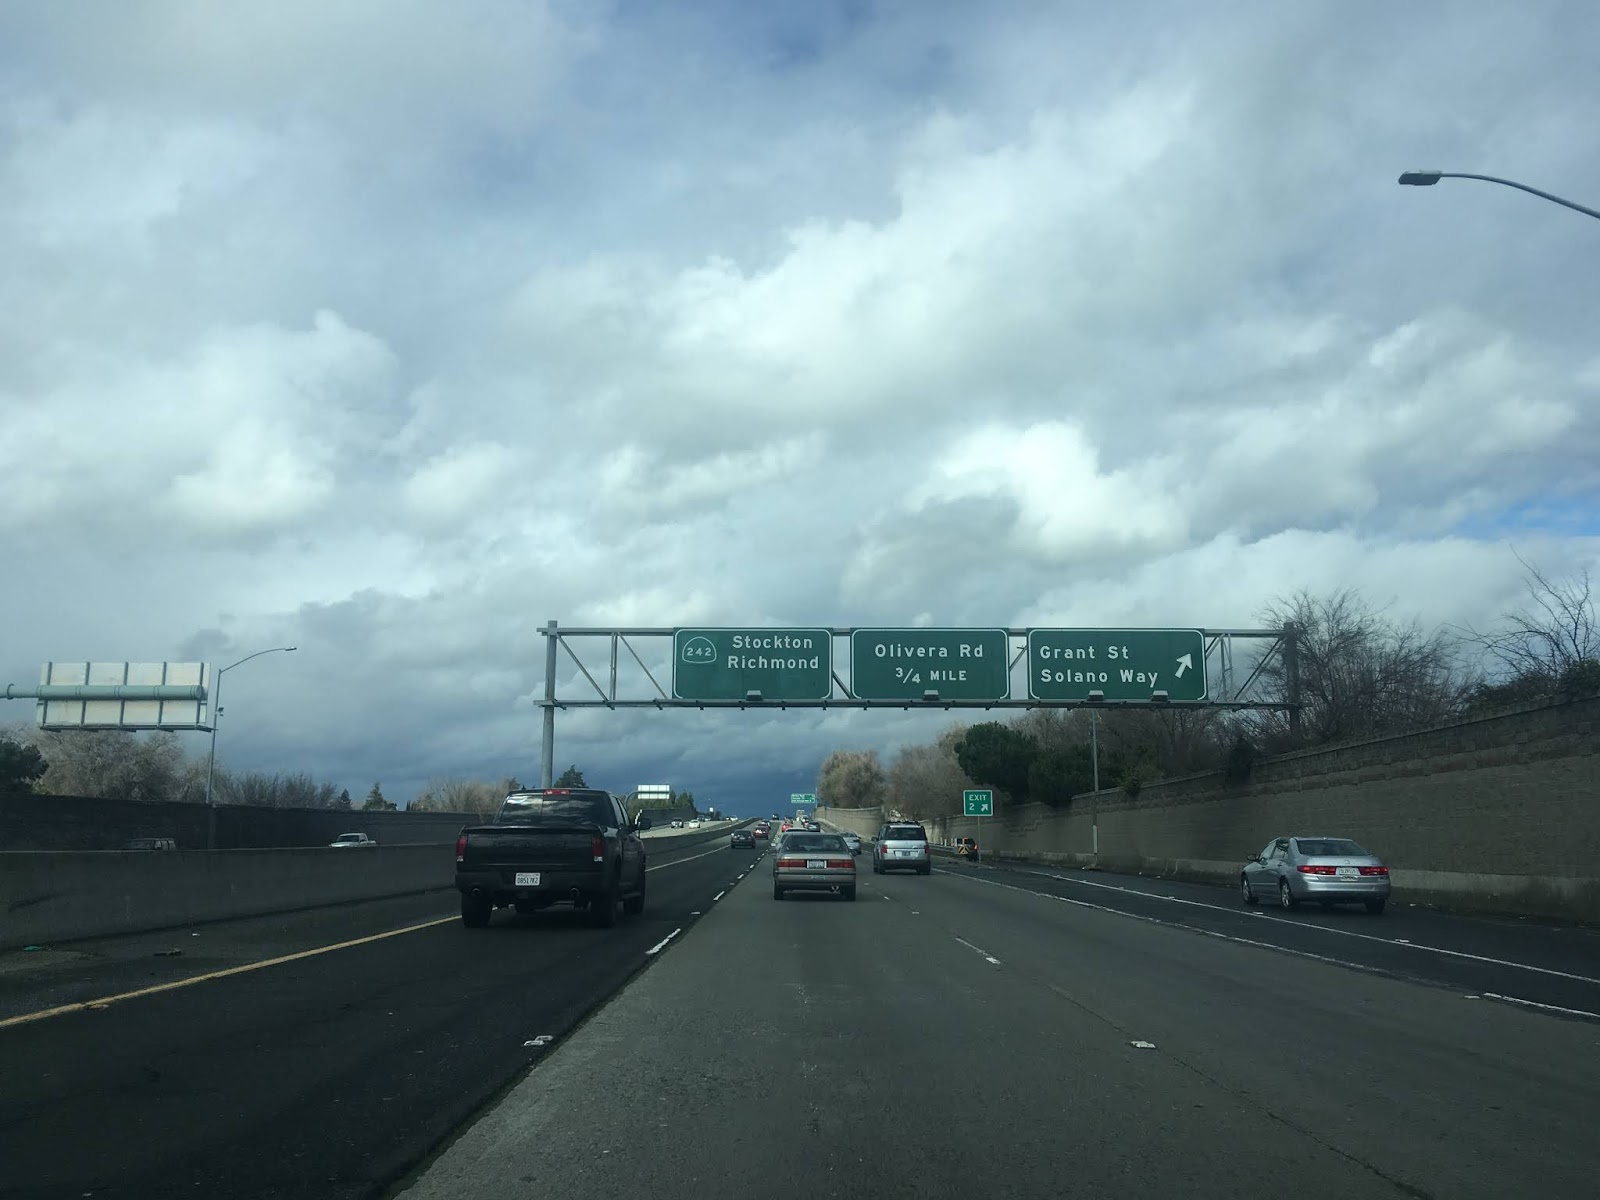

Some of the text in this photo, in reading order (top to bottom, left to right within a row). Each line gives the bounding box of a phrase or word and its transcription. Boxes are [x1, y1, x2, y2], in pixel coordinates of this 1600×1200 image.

[733, 636, 812, 649] Stockton
[686, 647, 713, 657] 242
[875, 643, 983, 657] Olivera Rd
[1040, 646, 1129, 659] Grant St
[728, 656, 819, 669] Richmond
[931, 671, 967, 681] MILE
[1041, 669, 1158, 687] Solano Way
[969, 802, 975, 811] 2
